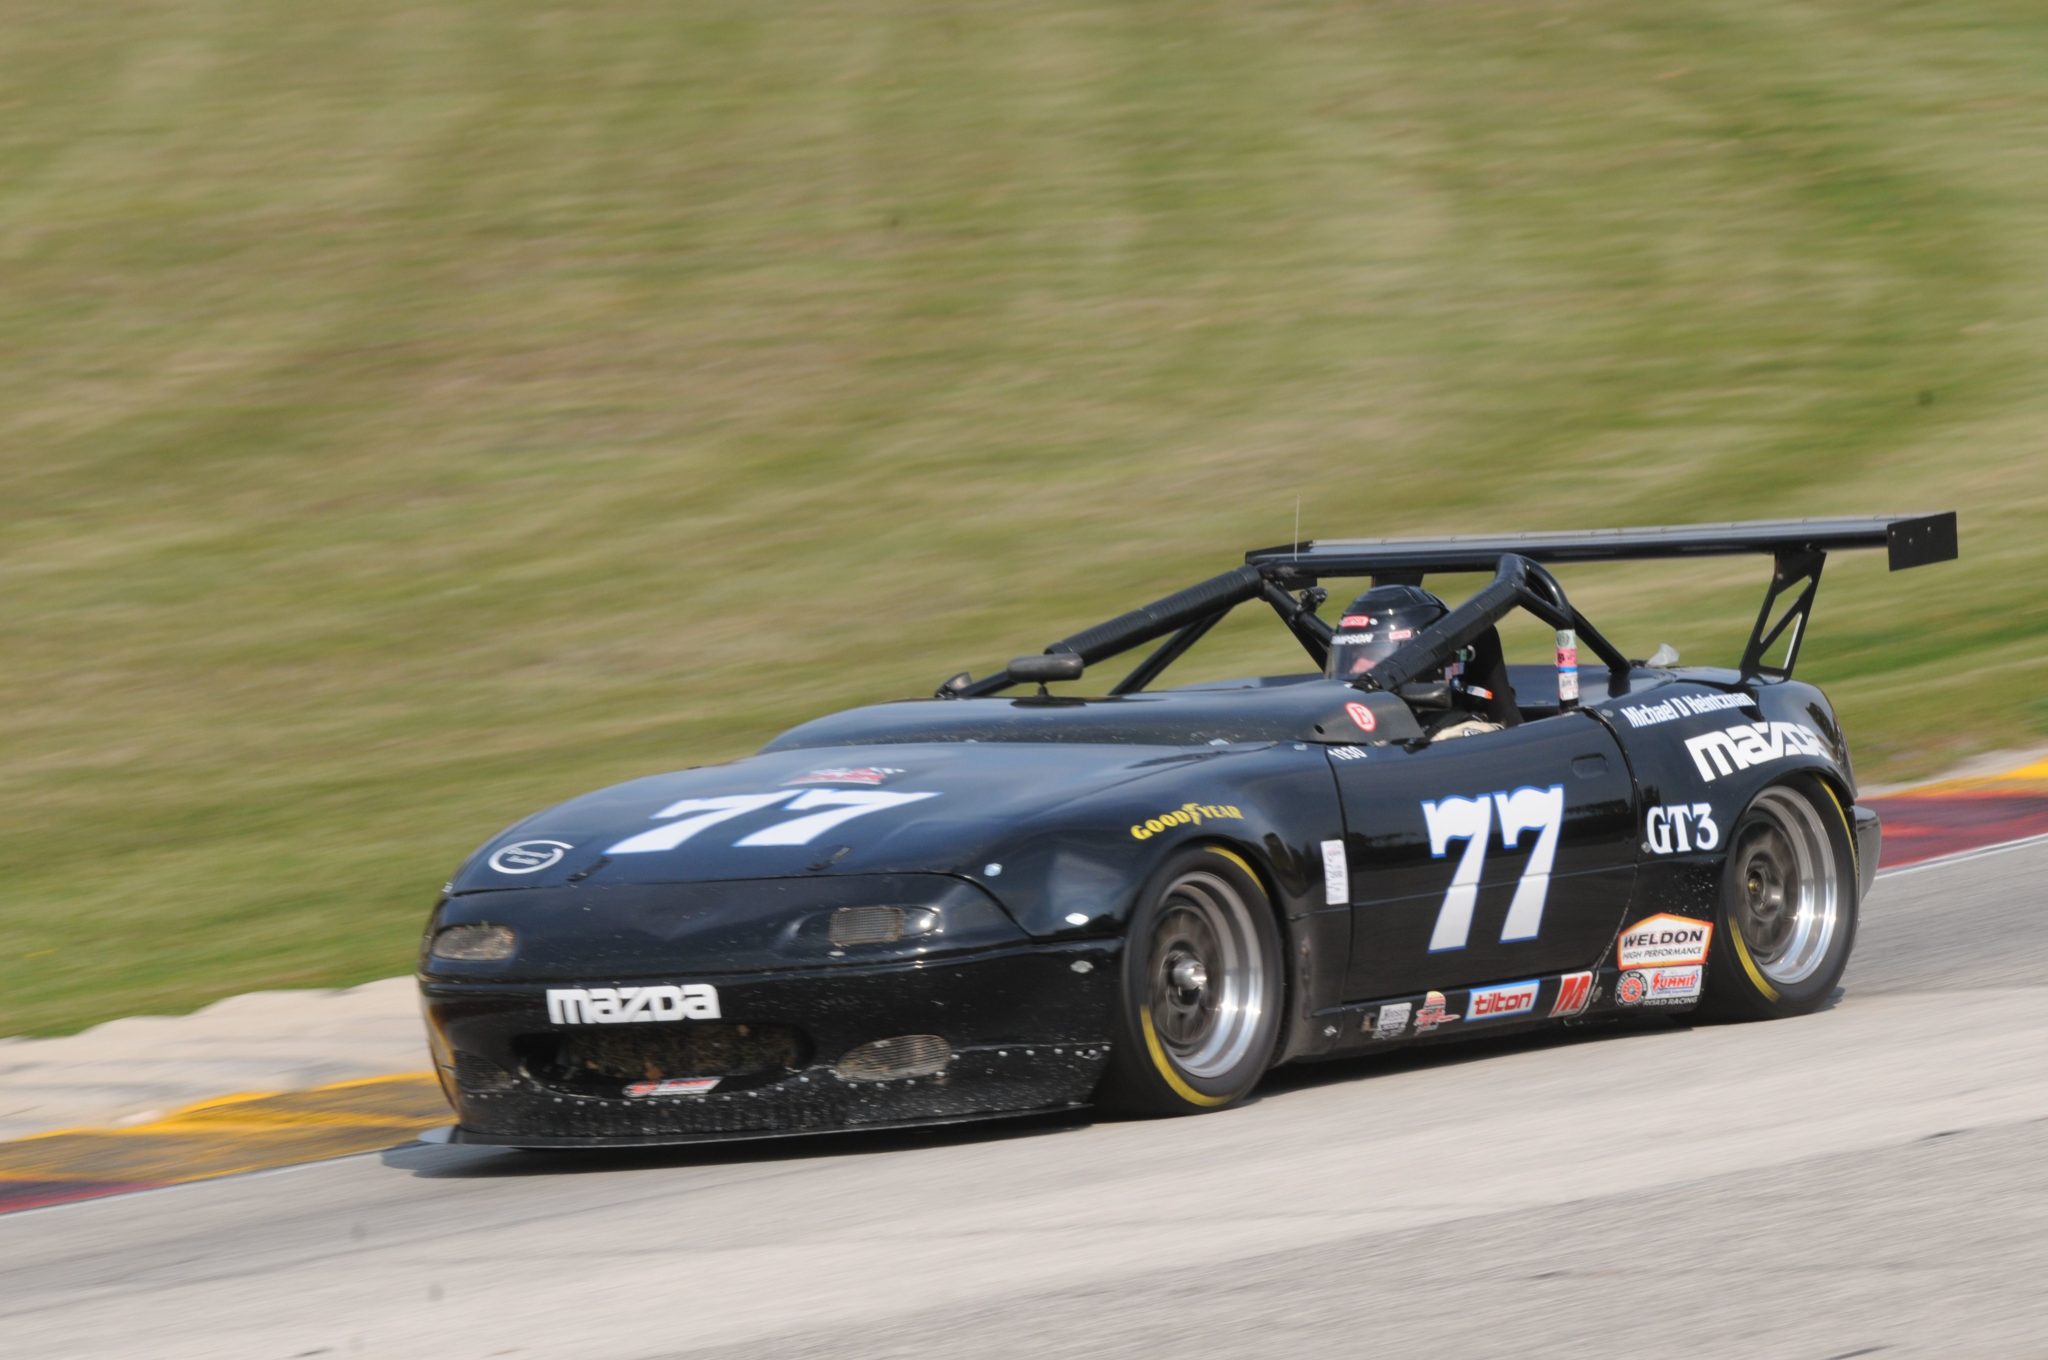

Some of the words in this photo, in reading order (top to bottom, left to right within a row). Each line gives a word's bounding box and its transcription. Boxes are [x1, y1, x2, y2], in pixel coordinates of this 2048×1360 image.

[1620, 699, 1680, 728] Michael
[1669, 697, 1692, 717] D
[607, 788, 940, 854] 77
[1130, 802, 1244, 840] GOODYEAR
[1647, 803, 1719, 854] GT3
[1420, 784, 1564, 954] 77
[1623, 930, 1703, 948] WELDON
[1623, 950, 1641, 960] HIGH
[1643, 946, 1702, 958] PERFORMANCE
[1474, 992, 1532, 1016] tilton
[1667, 996, 1698, 1006] RACING
